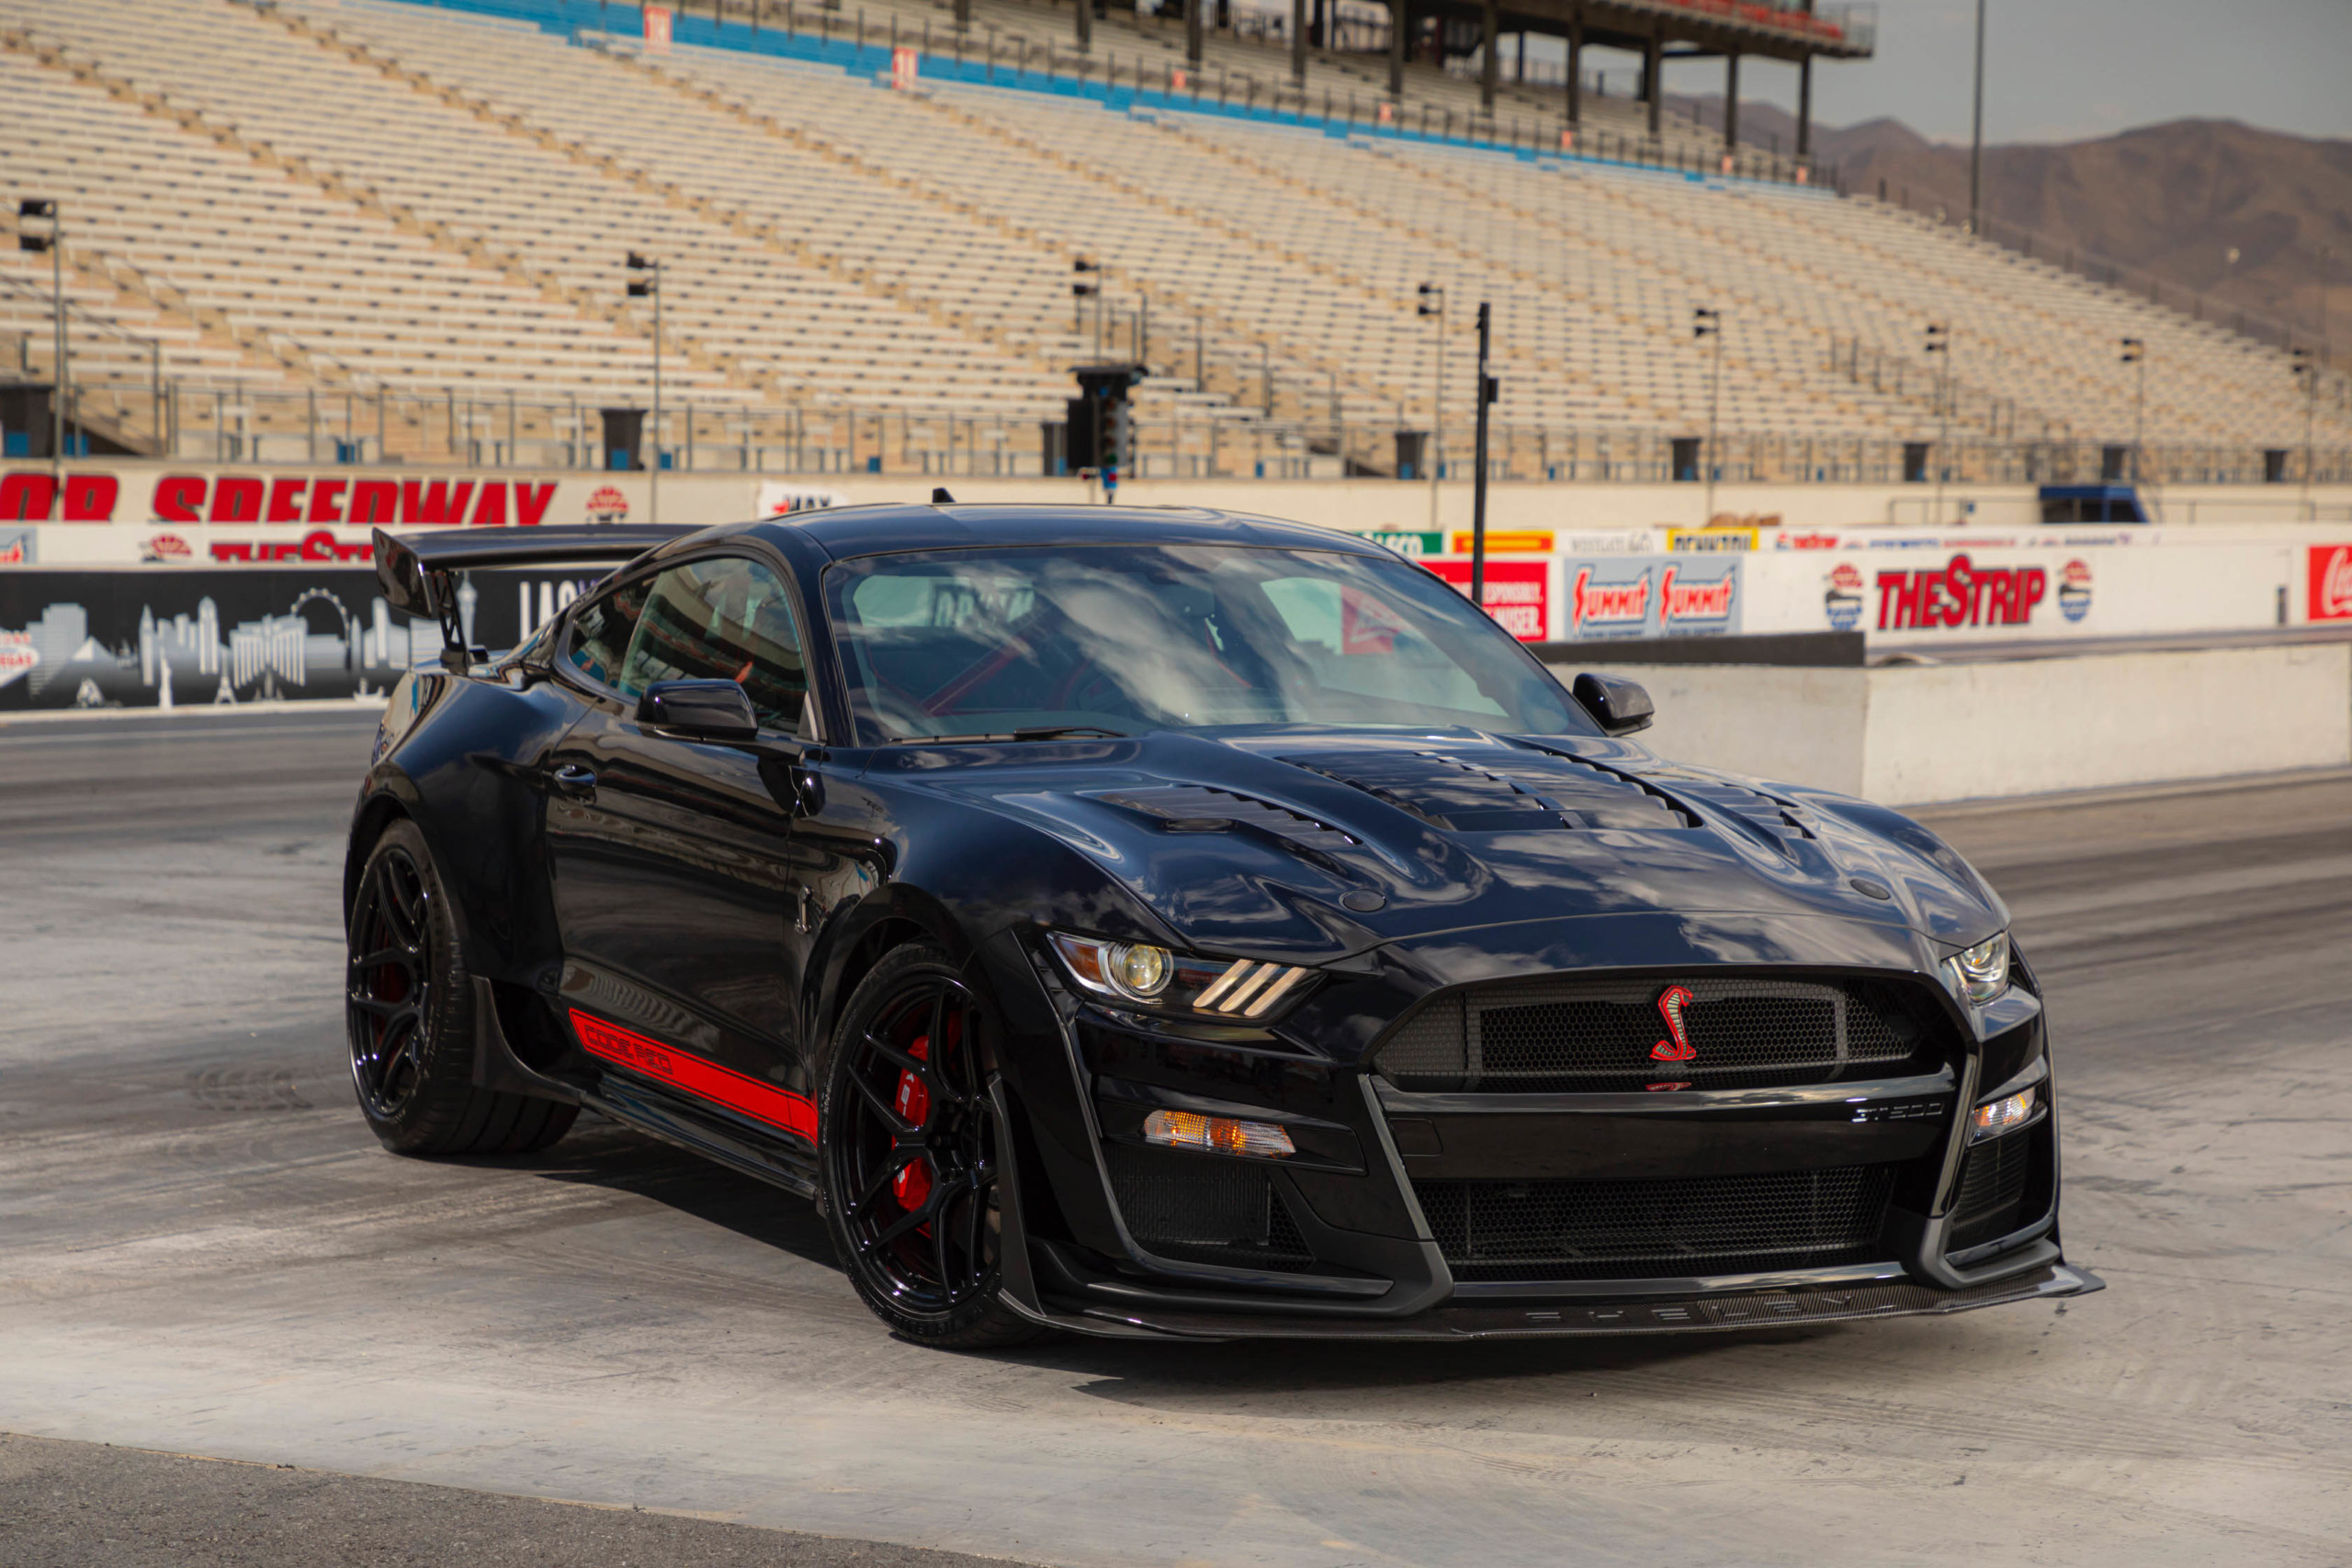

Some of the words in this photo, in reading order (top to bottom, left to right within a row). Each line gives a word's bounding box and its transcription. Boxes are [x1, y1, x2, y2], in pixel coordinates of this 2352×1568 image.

[151, 475, 558, 525] SPEEDWAY
[584, 1024, 636, 1060] CODE
[632, 1043, 674, 1075] RED
